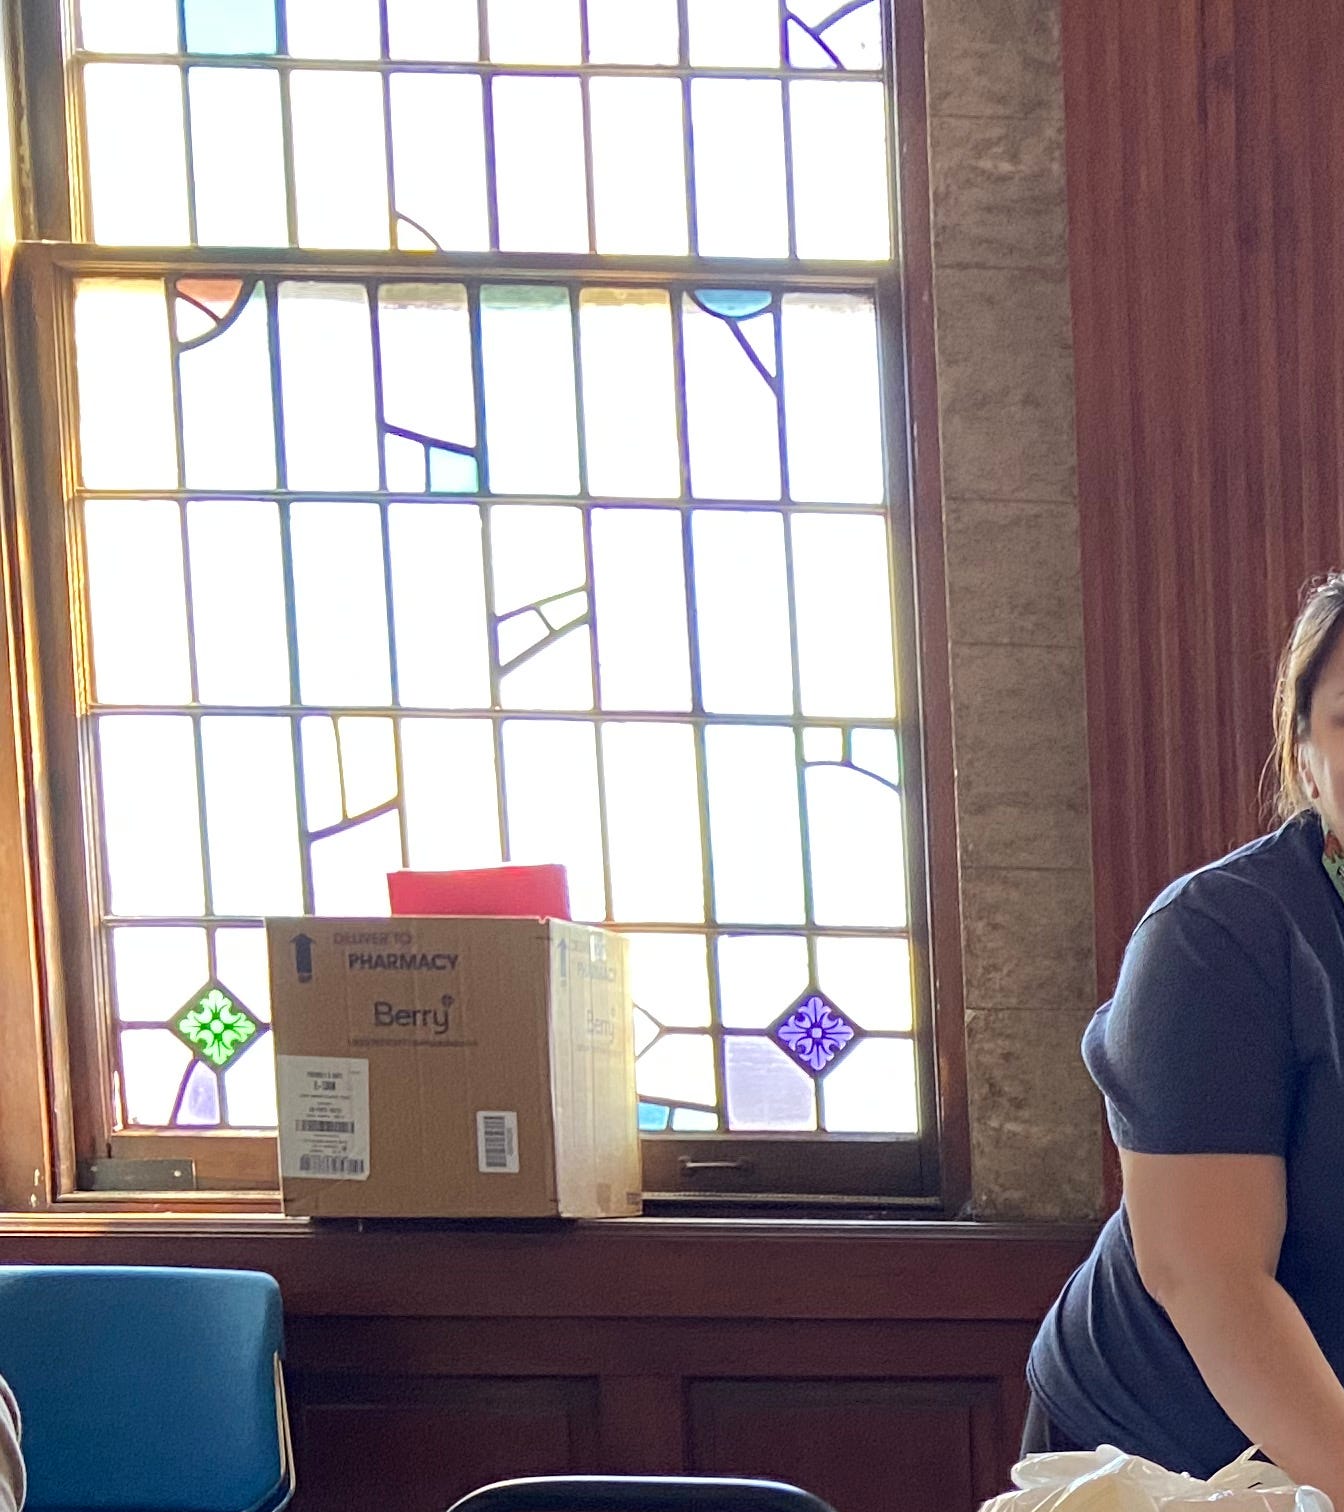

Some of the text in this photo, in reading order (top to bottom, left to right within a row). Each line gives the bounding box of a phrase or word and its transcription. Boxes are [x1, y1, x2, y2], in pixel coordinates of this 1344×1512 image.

[333, 932, 412, 945] DELIVER TO
[348, 953, 458, 970] PHARMACY
[374, 1001, 449, 1034] Berry
